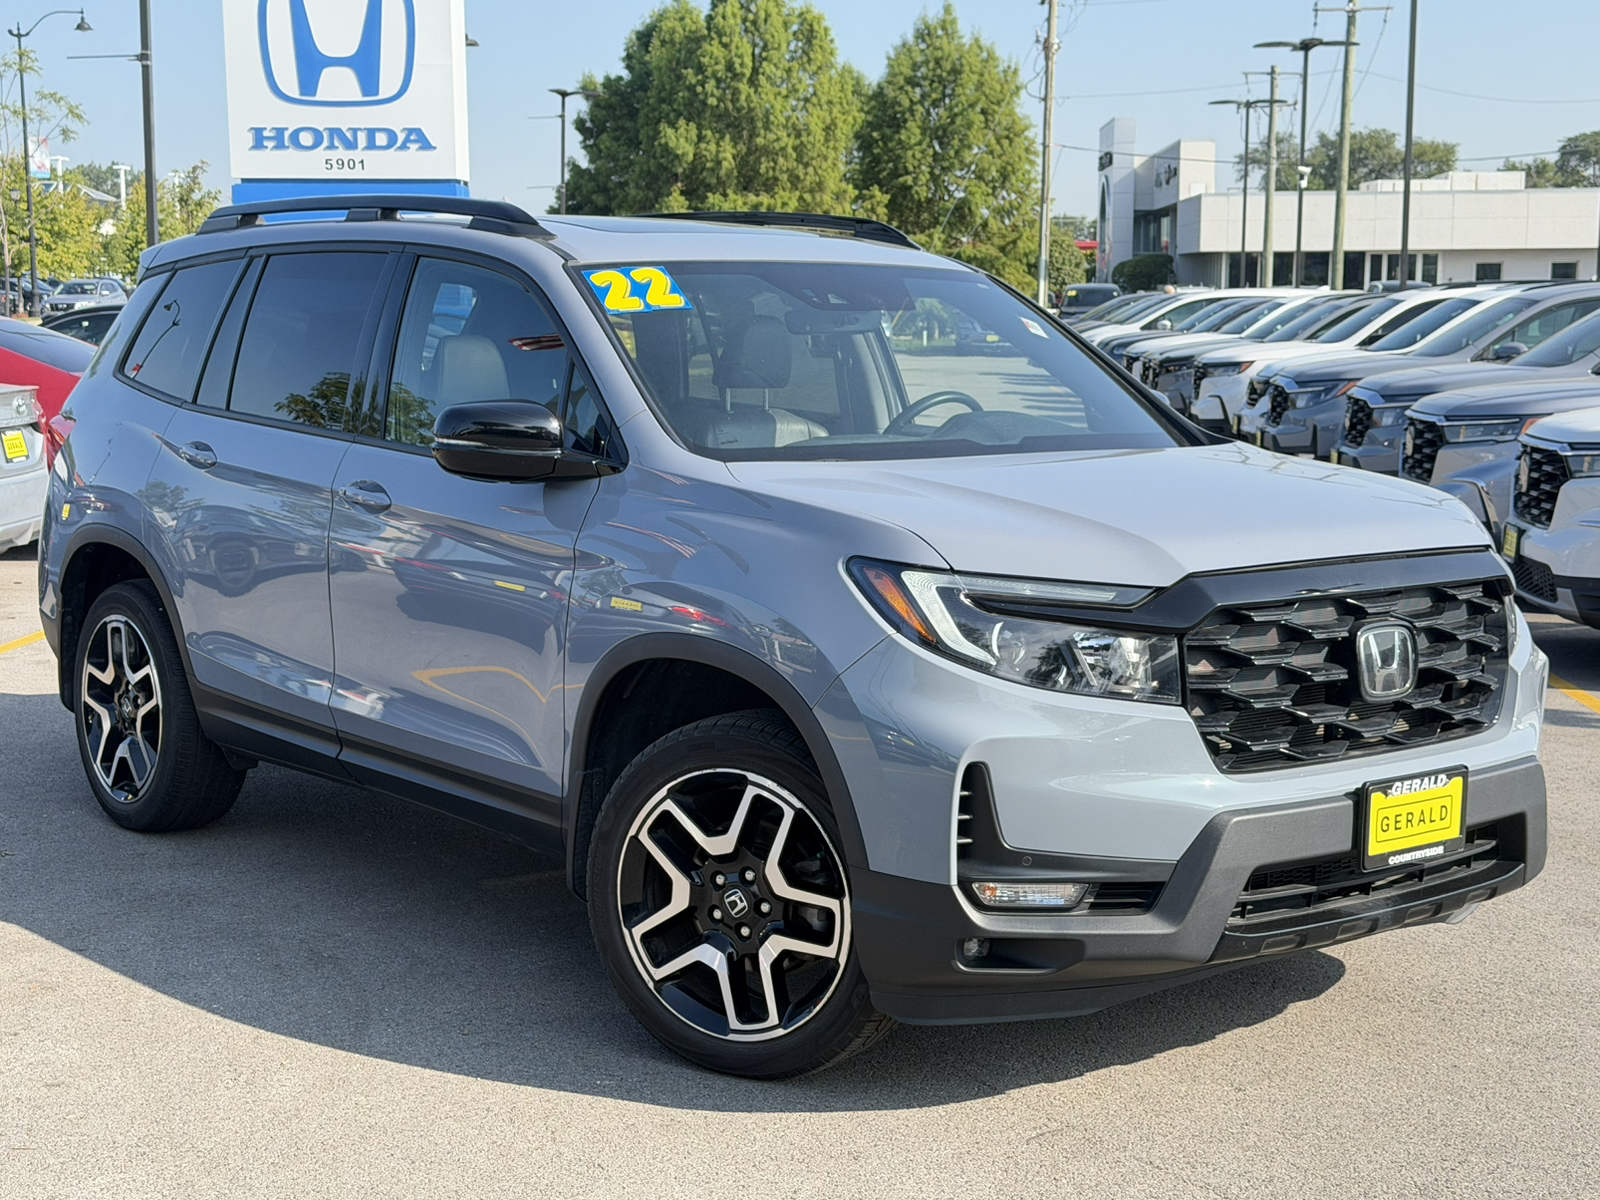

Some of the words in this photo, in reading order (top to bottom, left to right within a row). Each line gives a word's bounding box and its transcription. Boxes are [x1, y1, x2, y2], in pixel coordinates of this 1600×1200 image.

[248, 127, 437, 151] HONDA
[324, 158, 366, 171] 5901
[589, 267, 685, 312] 22
[1391, 774, 1446, 796] GERALD
[1380, 805, 1449, 833] GERALD
[1388, 846, 1444, 864] COUNTRYSIDE
